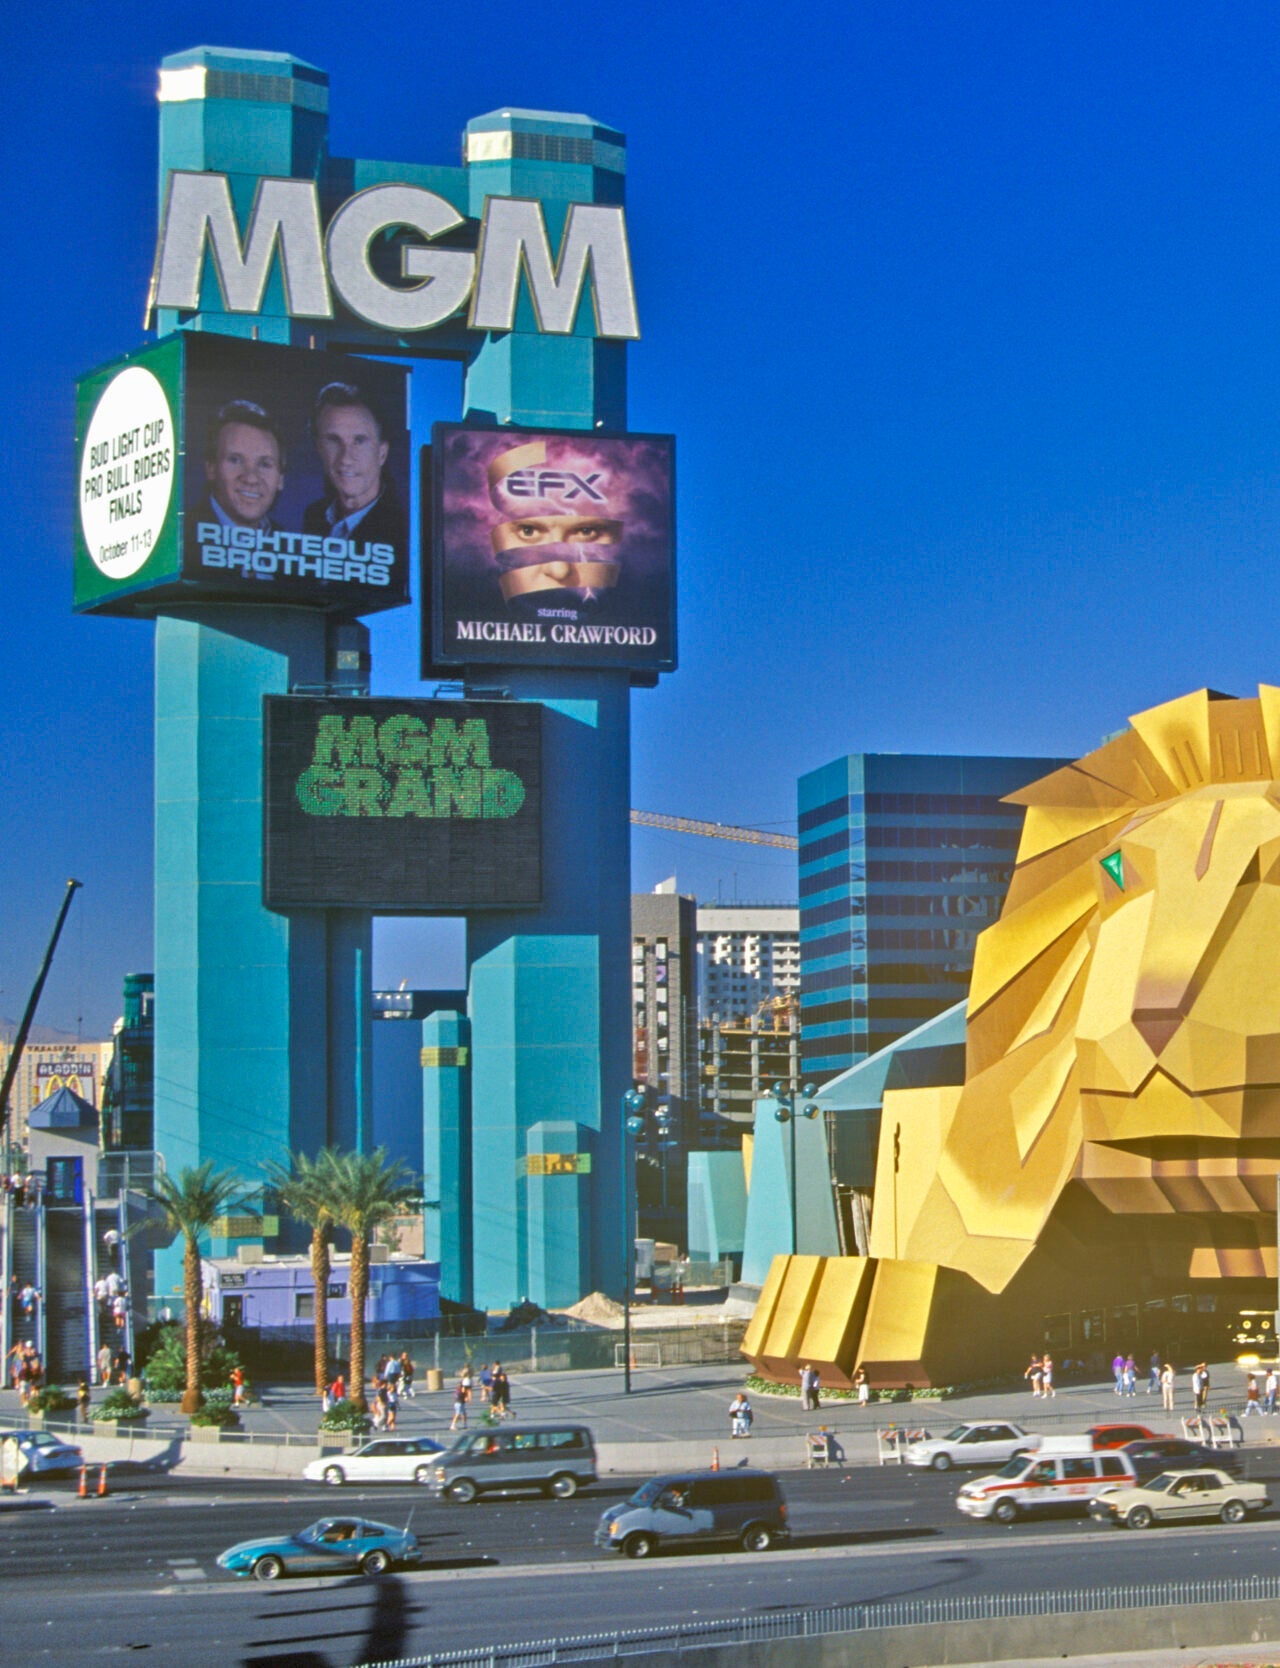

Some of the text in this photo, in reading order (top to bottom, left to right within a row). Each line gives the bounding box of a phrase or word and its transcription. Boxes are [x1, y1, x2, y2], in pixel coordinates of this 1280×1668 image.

[152, 169, 641, 339] MGM
[90, 418, 164, 470] BUD LIGHT CUP
[84, 447, 171, 503] PRO BULL RIDERS
[505, 469, 607, 502] EFX
[109, 490, 143, 523] FINALS
[99, 528, 152, 564] October 11-13
[197, 522, 395, 566] RIGHTEOUS
[201, 544, 390, 586] BROTHERS
[456, 621, 657, 646] MICHAEL CRAWFORD
[537, 607, 577, 620] starring
[312, 714, 492, 767] MGM
[295, 764, 526, 819] GRAND
[39, 1063, 92, 1075] ALADDIN
